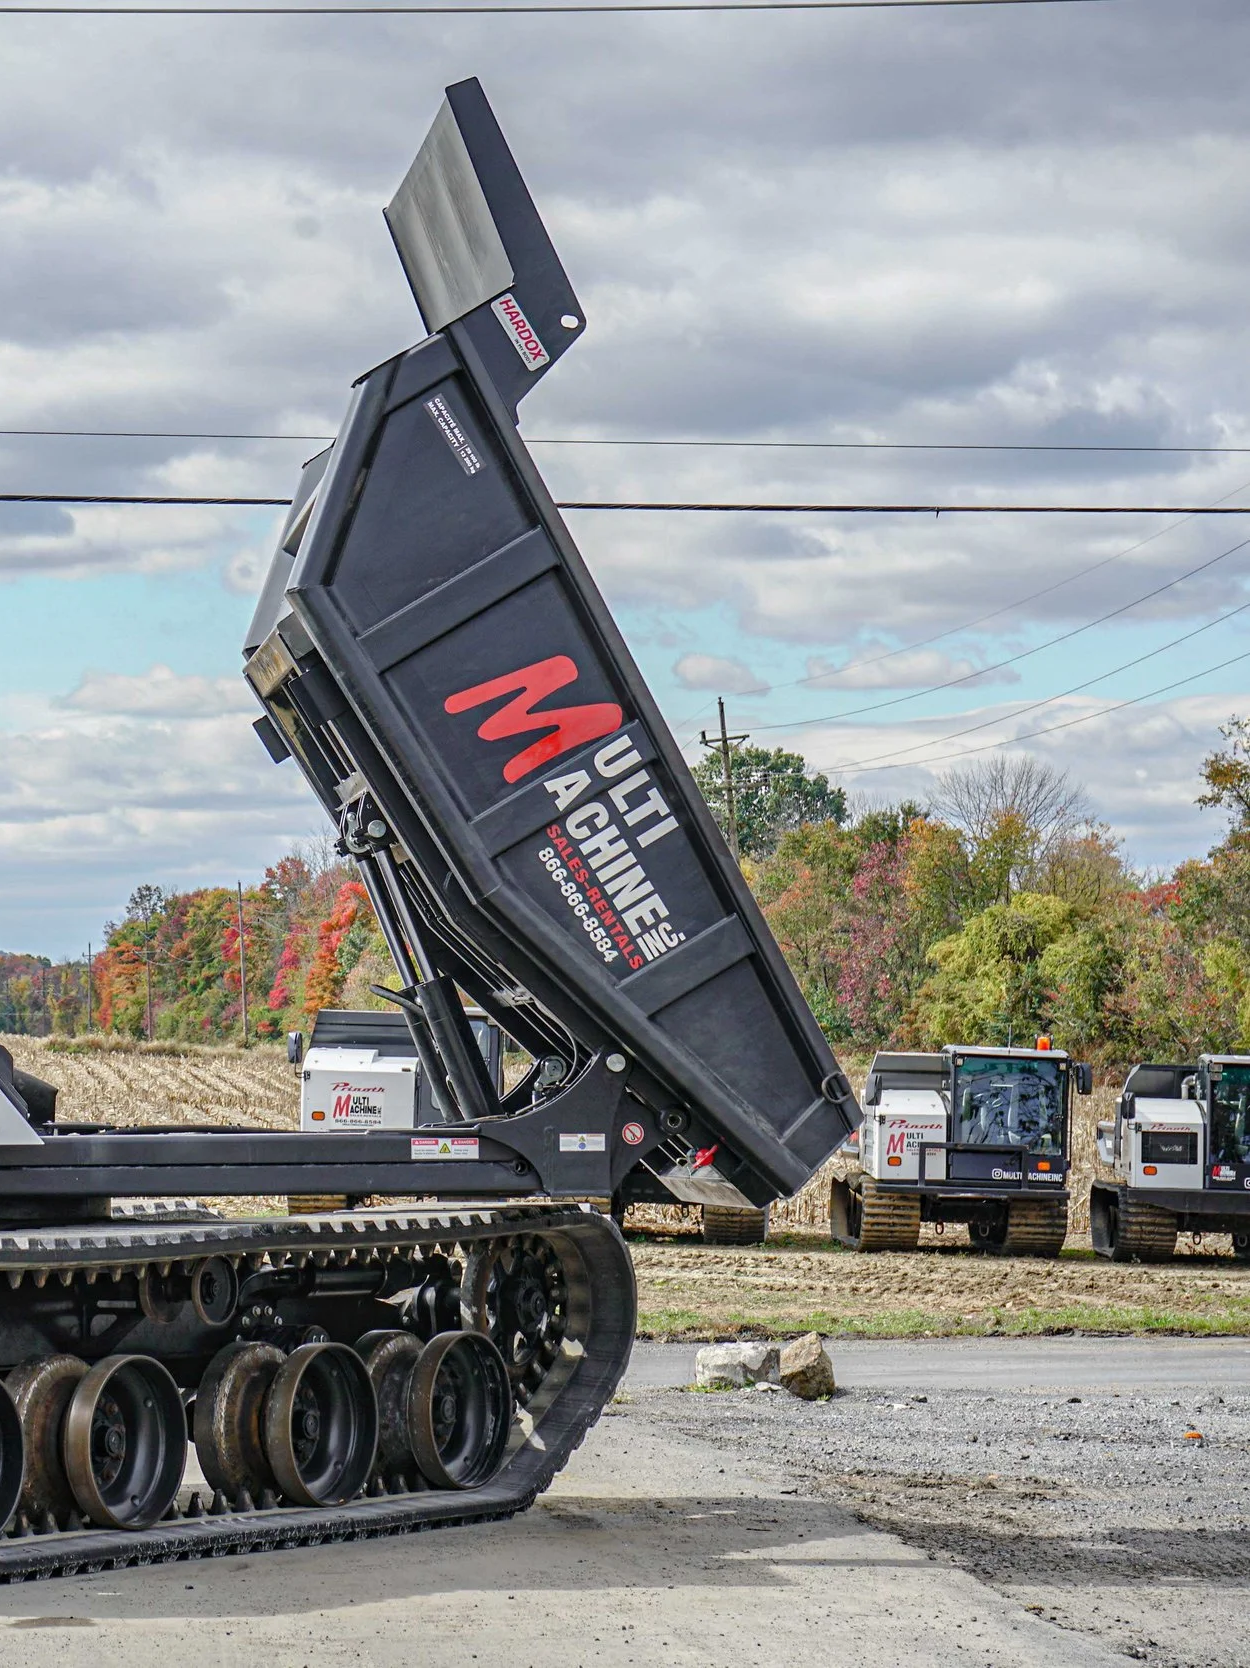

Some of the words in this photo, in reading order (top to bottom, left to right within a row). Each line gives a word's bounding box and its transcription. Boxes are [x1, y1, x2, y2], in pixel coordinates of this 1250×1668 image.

[499, 298, 545, 361] HARDOX
[521, 350, 533, 365] BODY
[427, 402, 439, 418] MAX.
[436, 416, 460, 448] CAPACITY
[434, 397, 457, 429] CAPACITÉ
[453, 426, 465, 444] MAX.
[538, 847, 619, 963] 866-866-8584
[546, 824, 644, 970] SALES-RENTALS
[635, 921, 687, 962] INC.
[330, 1082, 385, 1093] Prinoth
[886, 1119, 943, 1130] Prinoth
